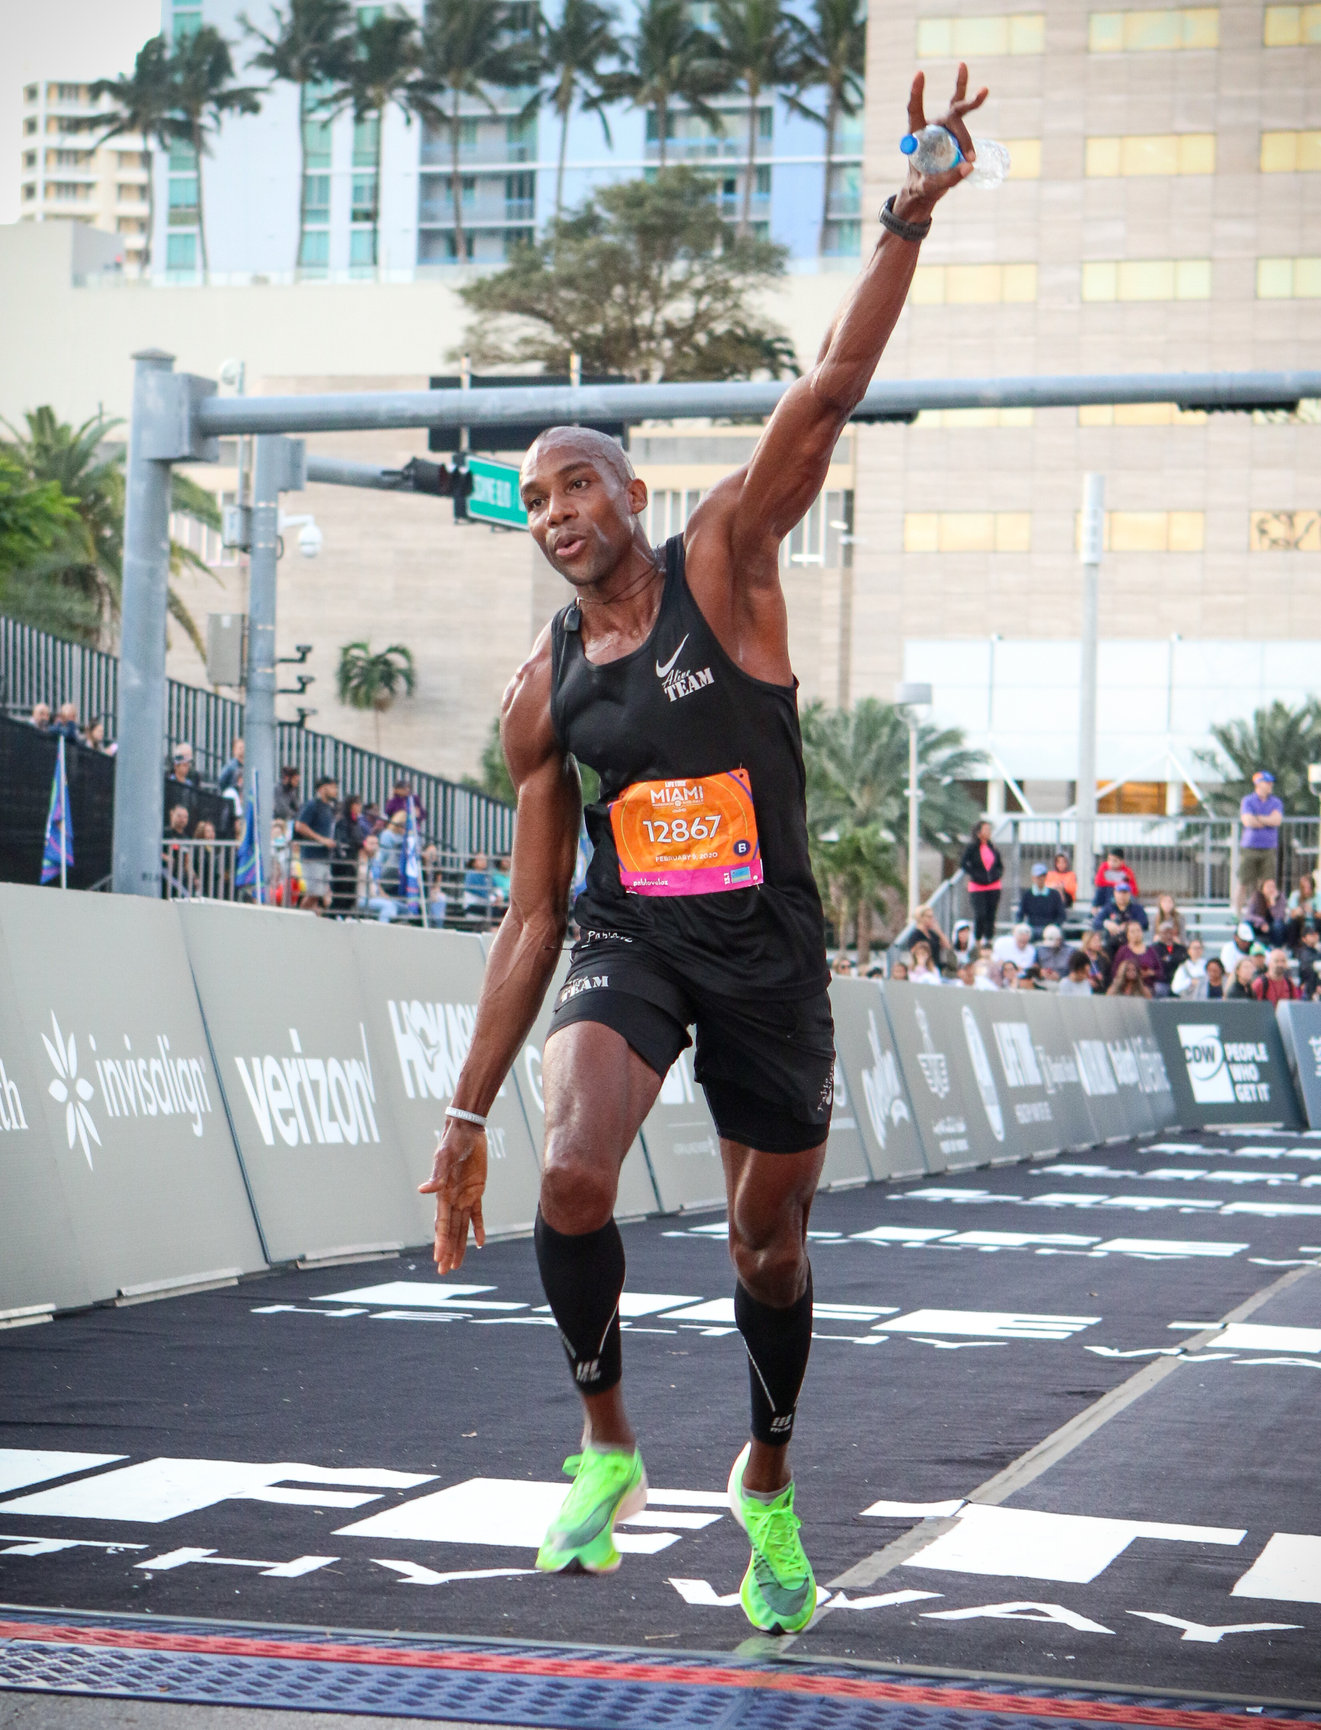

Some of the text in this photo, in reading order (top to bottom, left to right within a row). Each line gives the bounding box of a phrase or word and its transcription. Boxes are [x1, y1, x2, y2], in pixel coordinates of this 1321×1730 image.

[664, 667, 715, 702] TEAM
[650, 785, 704, 804] MIAMI
[642, 814, 722, 843] 12867
[738, 843, 747, 853] B
[655, 854, 691, 863] FEBRUARY
[1183, 1044, 1216, 1063] CDW
[1223, 1042, 1269, 1063] PEOPLE
[1229, 1063, 1260, 1082] WHO
[88, 1033, 213, 1138] invisalign
[233, 1027, 381, 1148] verizon
[1234, 1083, 1270, 1103] GET IT
